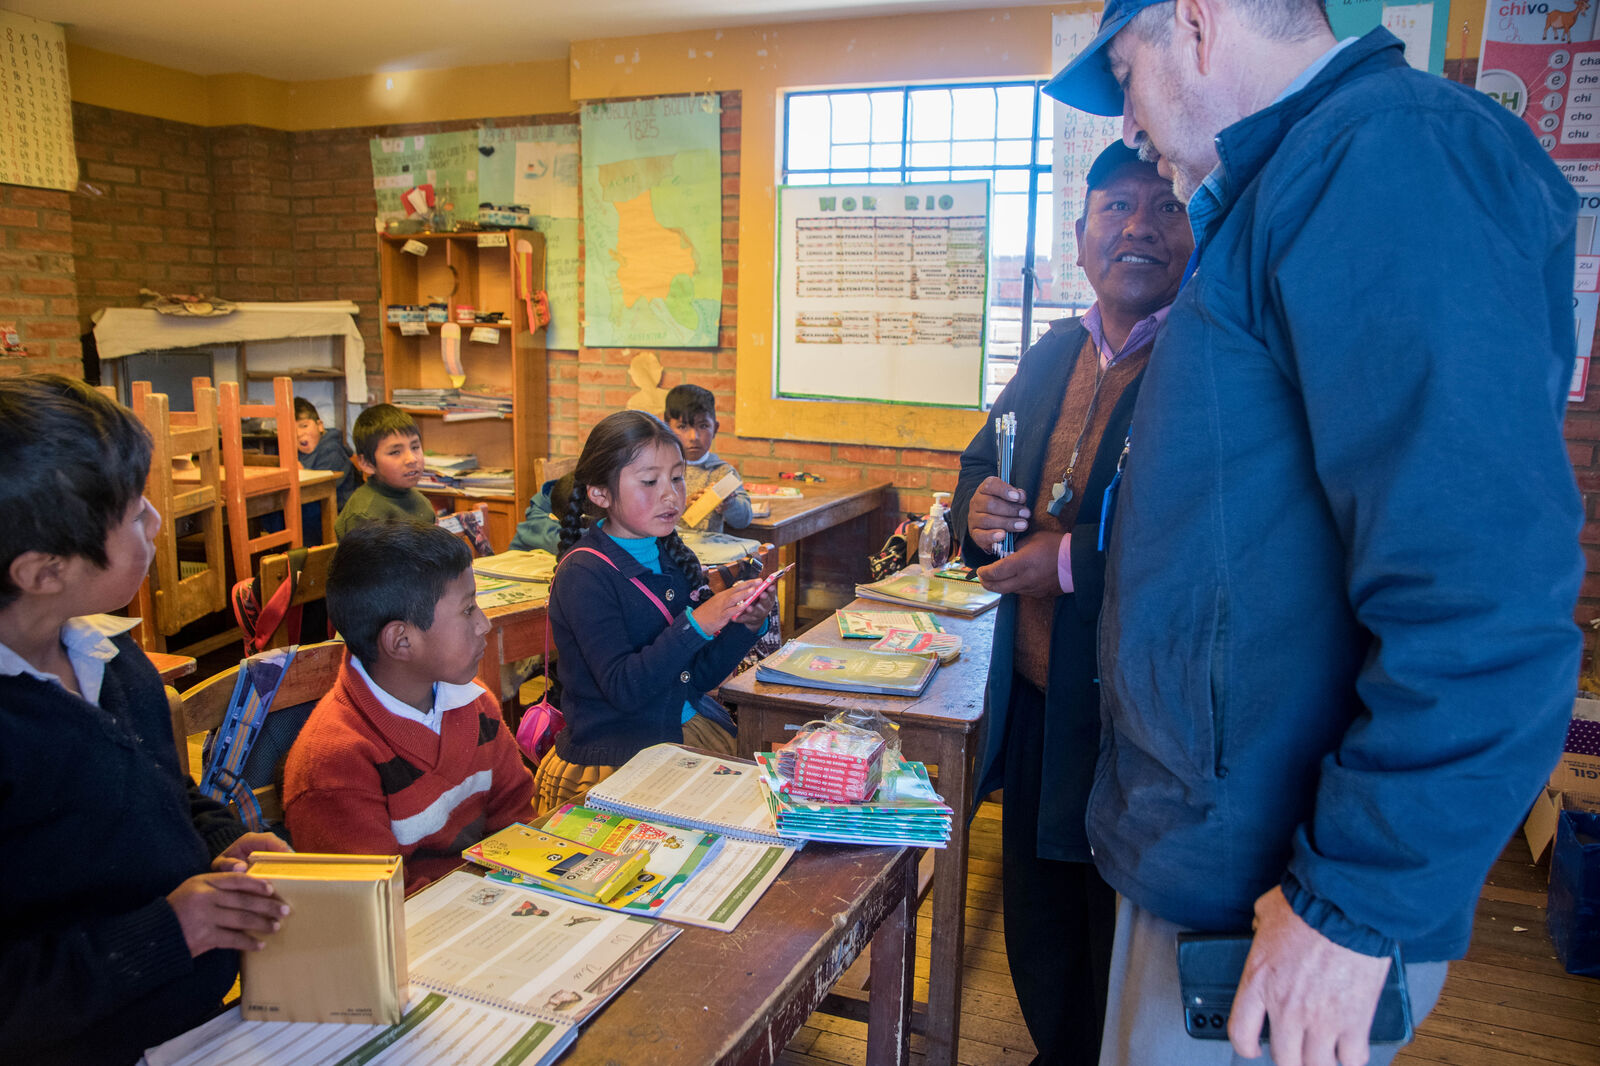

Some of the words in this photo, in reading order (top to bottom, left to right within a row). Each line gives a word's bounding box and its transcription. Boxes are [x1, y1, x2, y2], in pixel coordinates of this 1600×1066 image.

[1499, 2, 1549, 16] chivo
[6, 27, 14, 42] 8
[1554, 54, 1564, 64] a
[1580, 56, 1600, 66] cha
[1552, 75, 1560, 86] e
[1576, 75, 1598, 84] che
[1550, 96, 1556, 108] i
[1574, 93, 1592, 103] chi
[1544, 118, 1554, 128] o
[1570, 112, 1592, 120] cho
[624, 118, 660, 142] 1825
[1542, 139, 1551, 148] u
[1568, 130, 1589, 138] chu
[819, 196, 878, 212] HOR
[904, 194, 954, 212] RIO
[1569, 768, 1600, 780] GIL
[576, 814, 611, 845] ESCRIB
